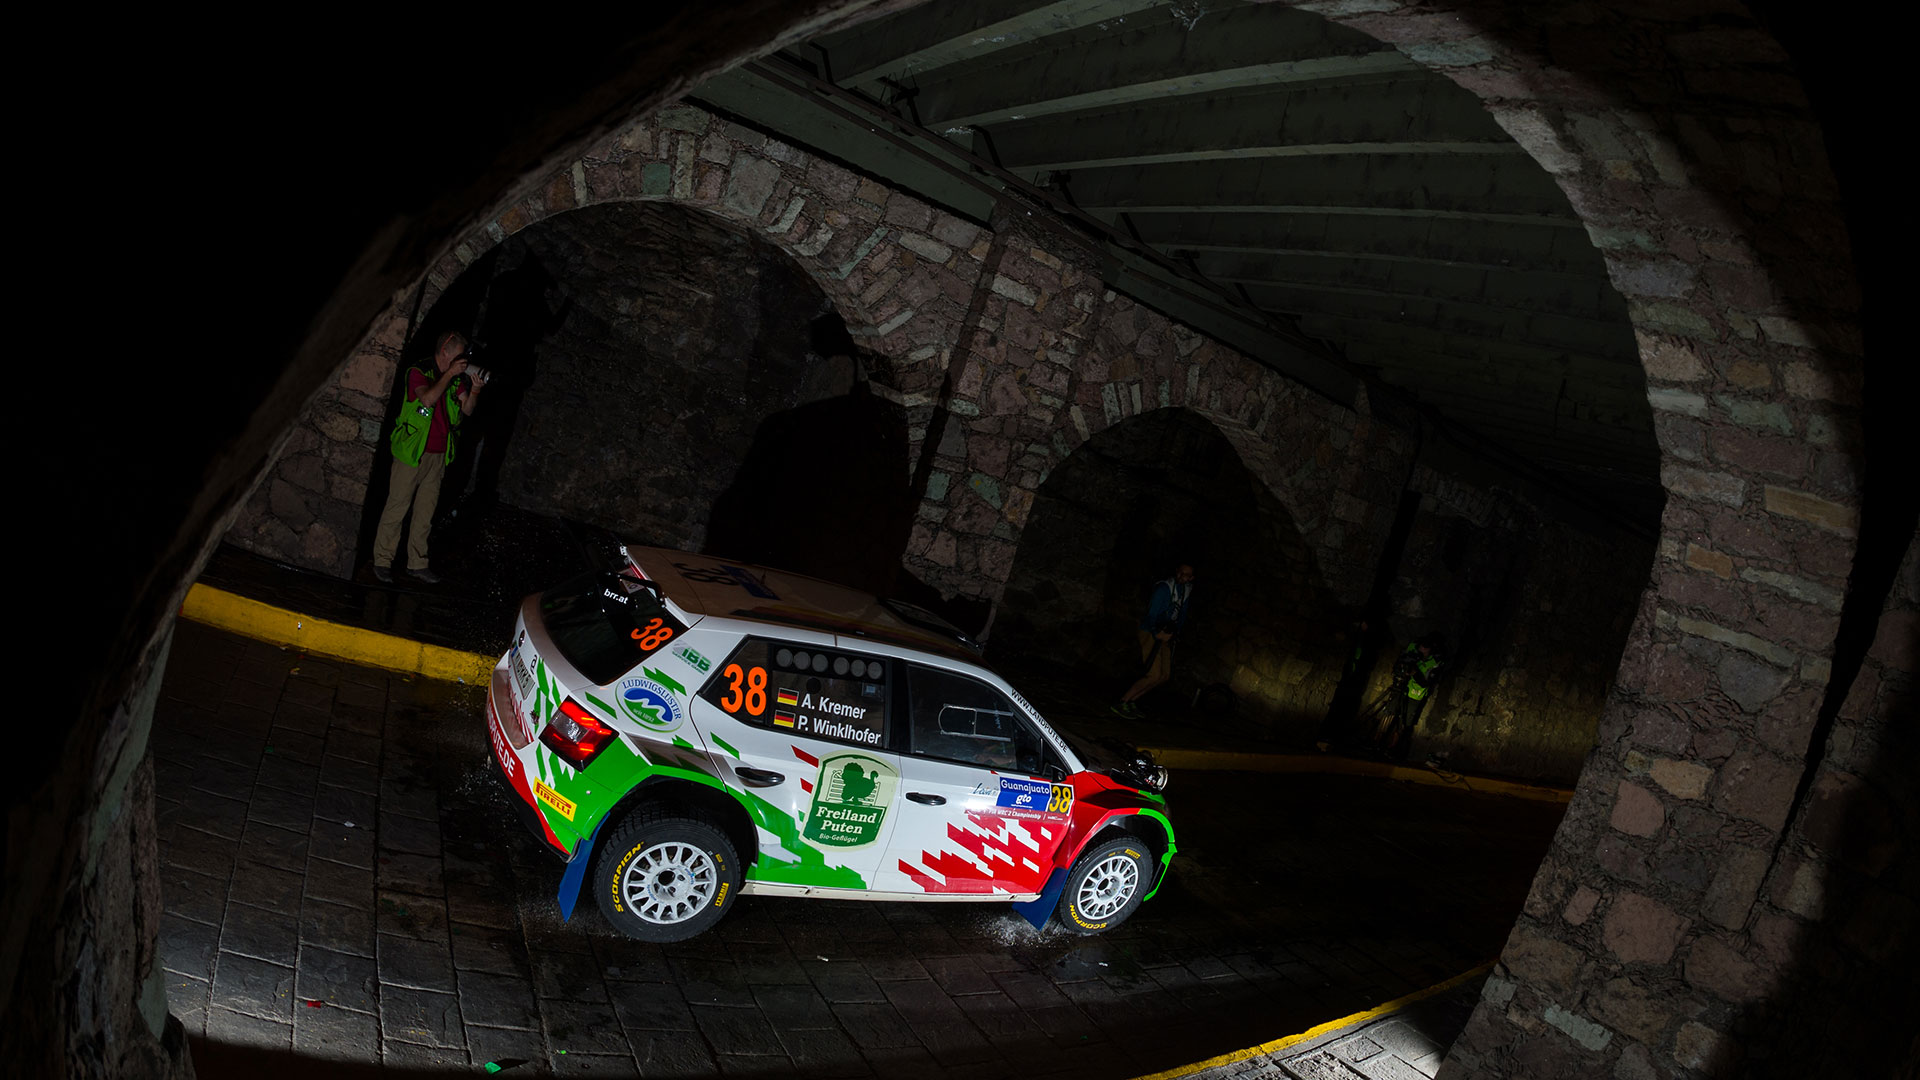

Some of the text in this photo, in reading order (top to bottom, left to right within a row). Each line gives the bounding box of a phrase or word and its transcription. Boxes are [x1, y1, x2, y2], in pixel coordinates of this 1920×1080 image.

[604, 588, 629, 605] brr.at
[631, 617, 673, 651] 38
[622, 679, 682, 720] LUDWIGSLUSTER
[721, 663, 768, 716] 38
[801, 693, 866, 720] A. Kremer
[797, 714, 882, 744] P. Winklhofer
[536, 781, 572, 816] PIRELLI
[1001, 780, 1050, 794] Guanajuato
[1016, 794, 1032, 805] gto
[1049, 785, 1072, 813] 38
[816, 806, 878, 824] Freiland
[820, 820, 863, 834] Puten
[611, 843, 643, 912] SCORPION
[1070, 904, 1107, 930] SCORPION
